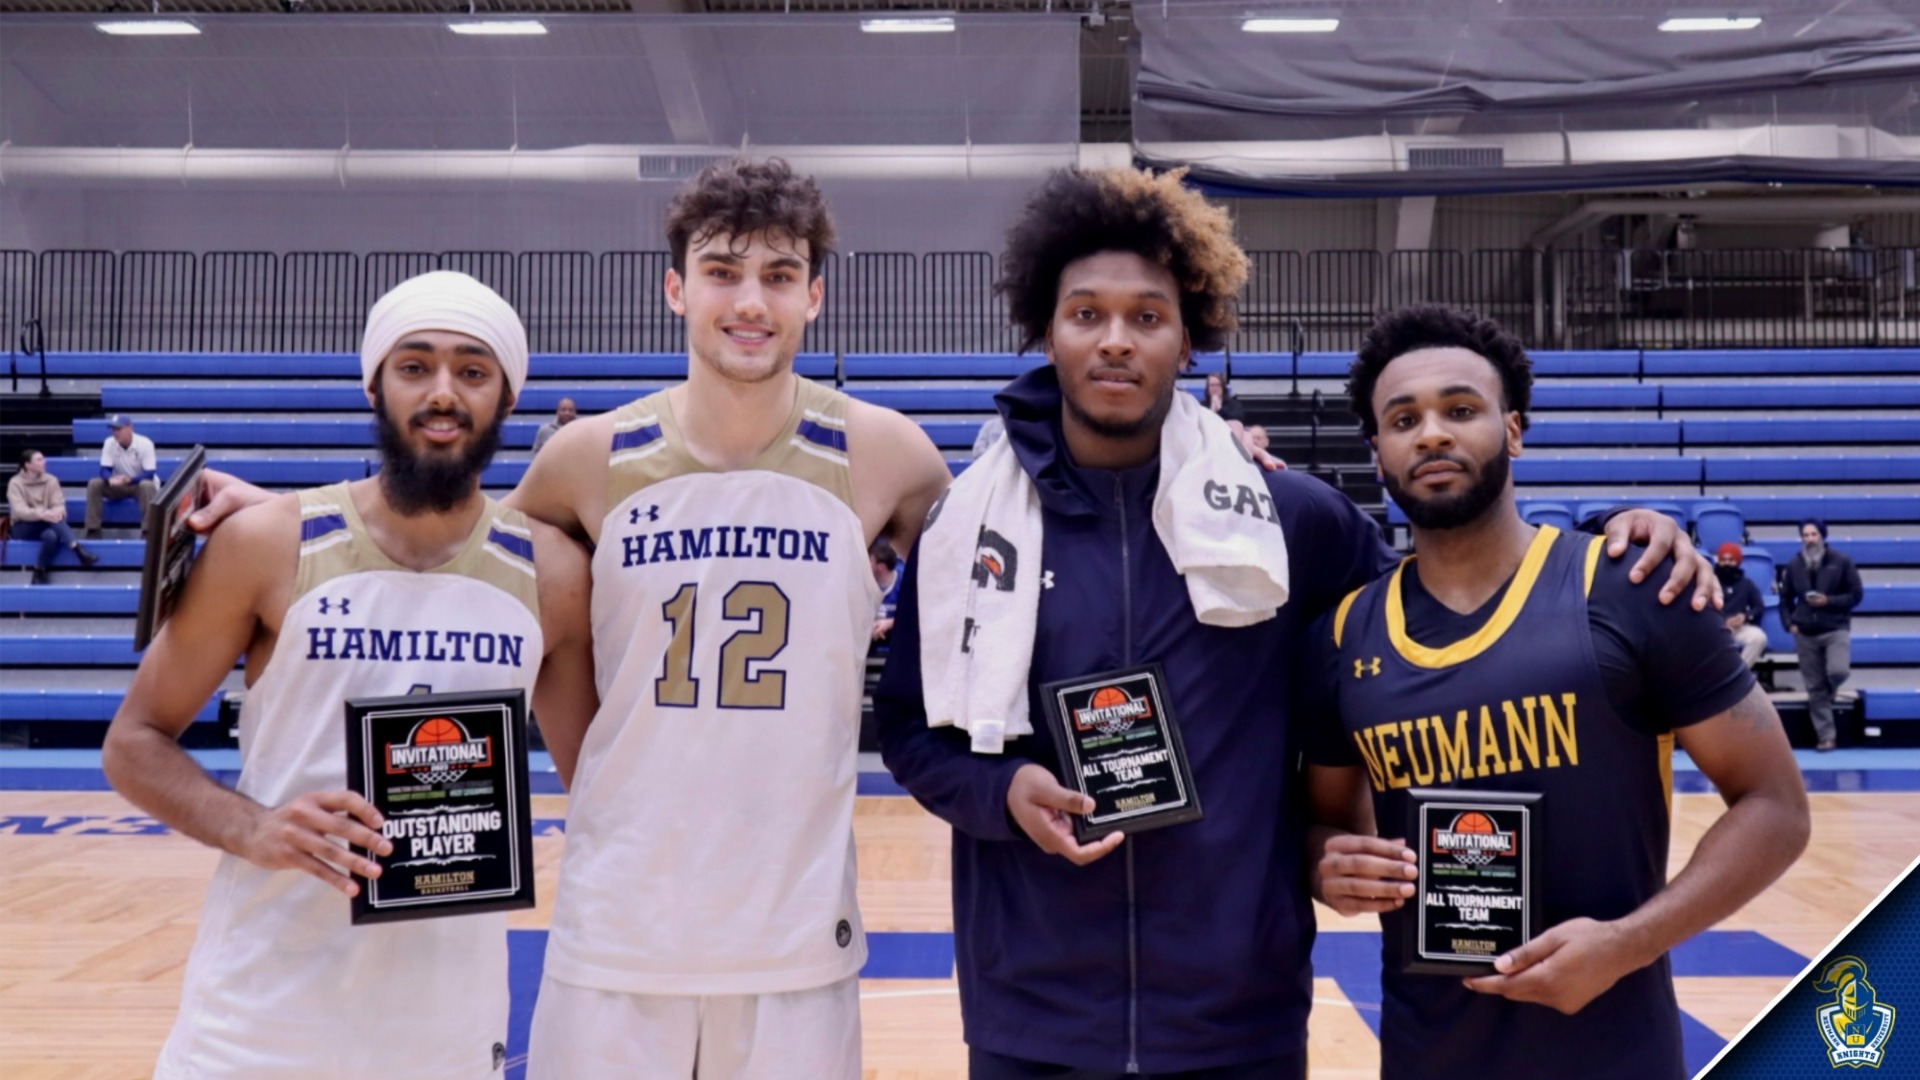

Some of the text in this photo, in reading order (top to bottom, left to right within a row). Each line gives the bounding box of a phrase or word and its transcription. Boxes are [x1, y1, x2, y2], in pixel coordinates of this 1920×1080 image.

[622, 526, 829, 568] HAMILTON
[306, 627, 523, 667] HAMILTON
[655, 581, 791, 710] 12
[1079, 701, 1146, 724] INVITATIONAL
[391, 743, 486, 765] INVITATIONAL
[1354, 693, 1579, 792] NEUMANN
[1082, 749, 1168, 777] ALL TOURNAMENT
[1114, 766, 1143, 782] TEAM
[382, 811, 502, 839] OUTSTANDING
[411, 833, 475, 857] PLAYER
[1437, 833, 1511, 850] INVITATIONAL
[415, 871, 475, 887] HAMILTON
[1426, 892, 1523, 910] ALL TOURNAMENT
[1458, 907, 1490, 922] TEAM
